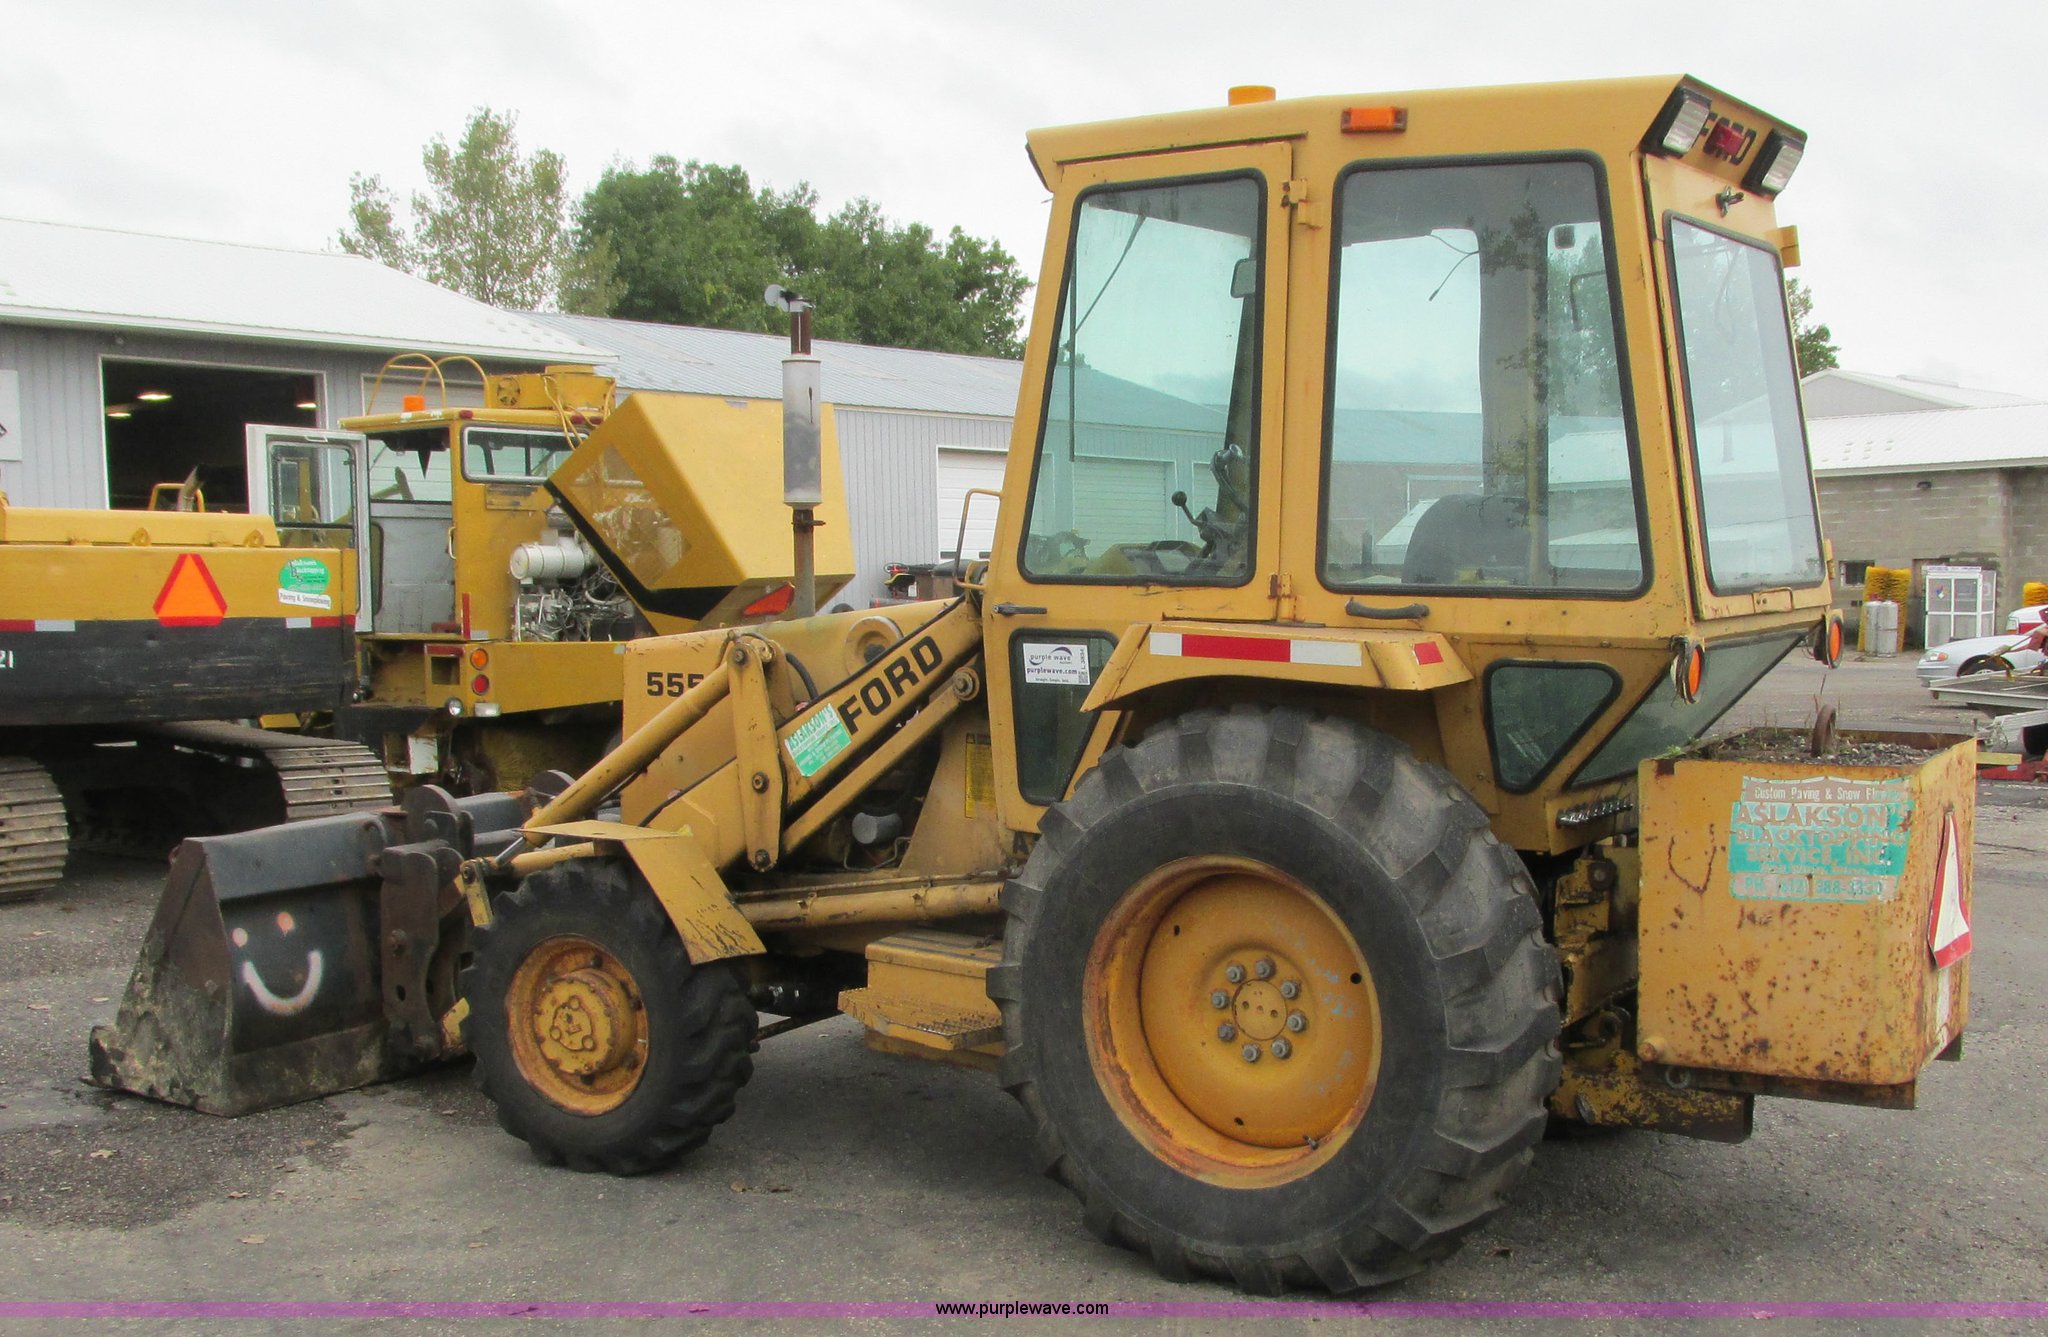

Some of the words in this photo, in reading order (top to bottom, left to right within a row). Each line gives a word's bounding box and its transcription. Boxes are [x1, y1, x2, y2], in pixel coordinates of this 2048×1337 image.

[1026, 667, 1078, 675] purplewave.com
[837, 635, 943, 735] FORD
[1754, 786, 1786, 800] Custom
[1791, 786, 1820, 802] Paving
[1825, 787, 1833, 800] &
[1837, 787, 1861, 800] Snow
